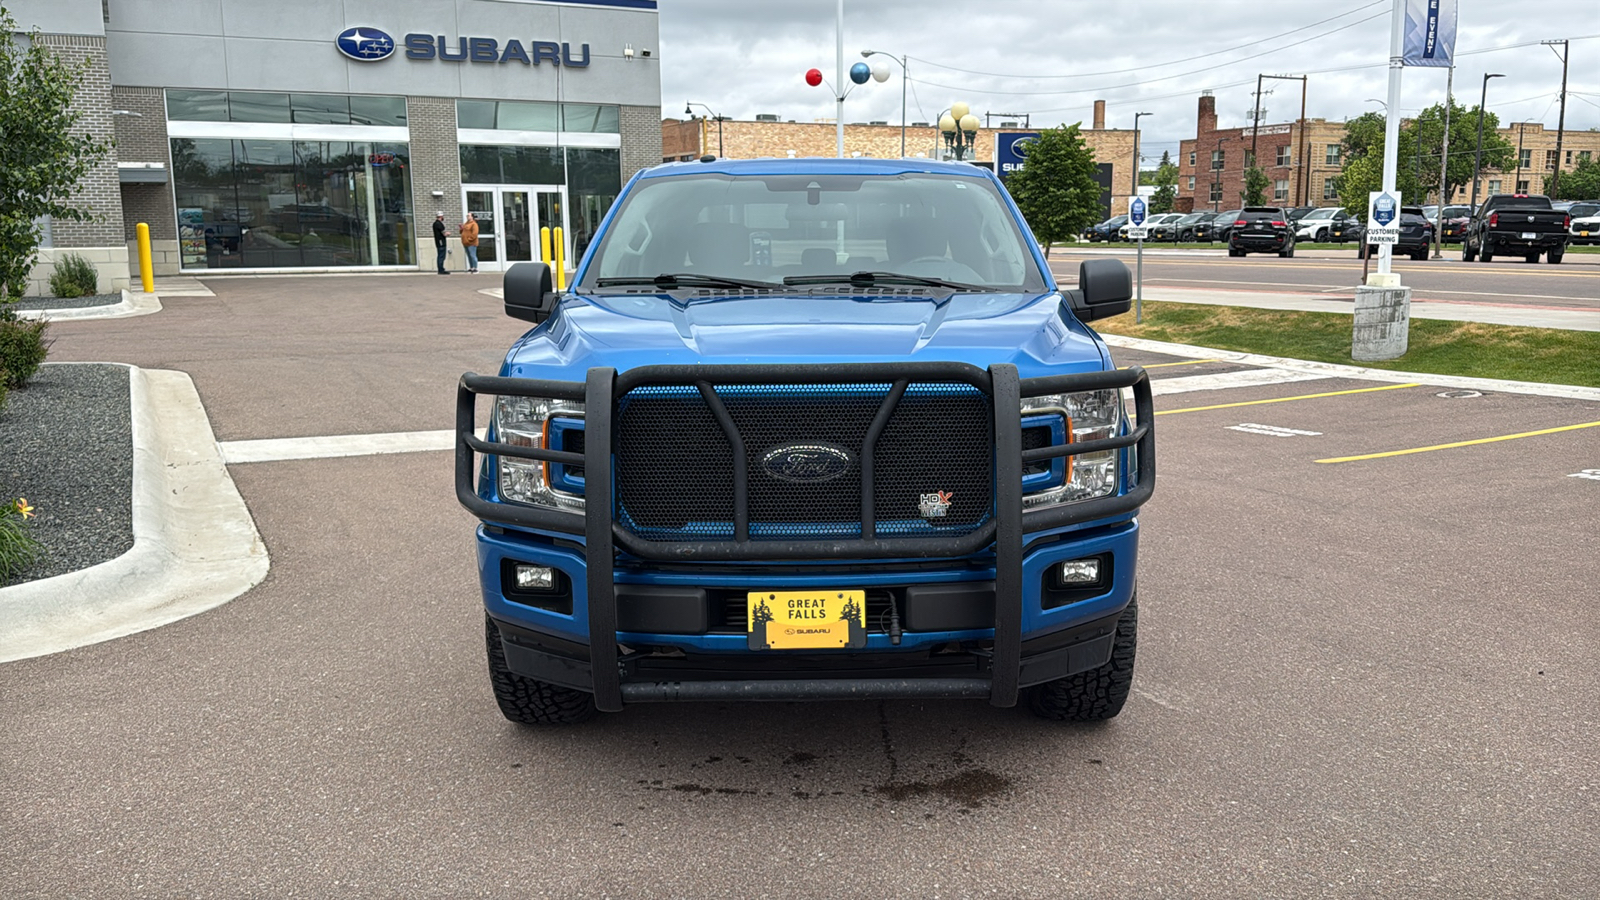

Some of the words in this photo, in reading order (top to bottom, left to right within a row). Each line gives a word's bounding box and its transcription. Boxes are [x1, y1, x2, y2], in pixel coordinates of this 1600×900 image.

[1427, 16, 1436, 54] EVENT
[405, 33, 590, 67] SUBARU
[368, 153, 394, 165] OPEN
[920, 490, 953, 505] HDX
[788, 599, 826, 608] GREAT
[788, 609, 826, 619] FALLS
